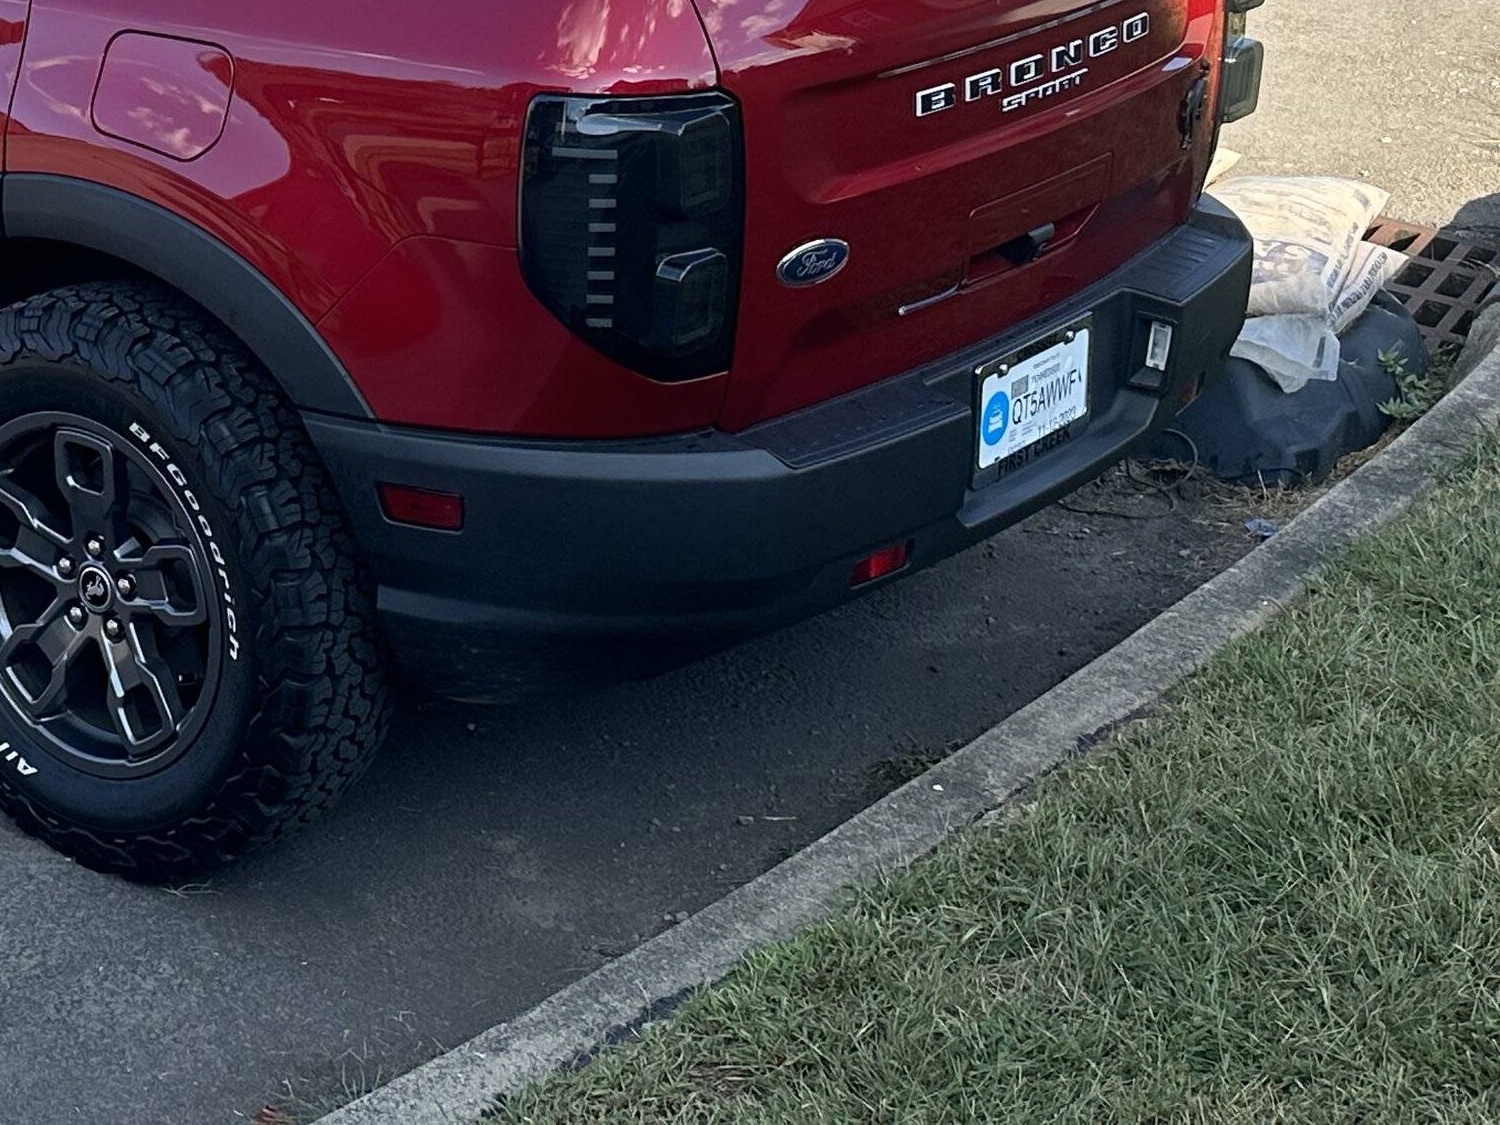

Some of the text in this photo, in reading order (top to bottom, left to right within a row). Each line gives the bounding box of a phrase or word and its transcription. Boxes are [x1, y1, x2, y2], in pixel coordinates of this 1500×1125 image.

[915, 11, 1150, 117] BRONCO
[1001, 68, 1089, 113] SPORT
[128, 421, 240, 662] BFGoodrich
